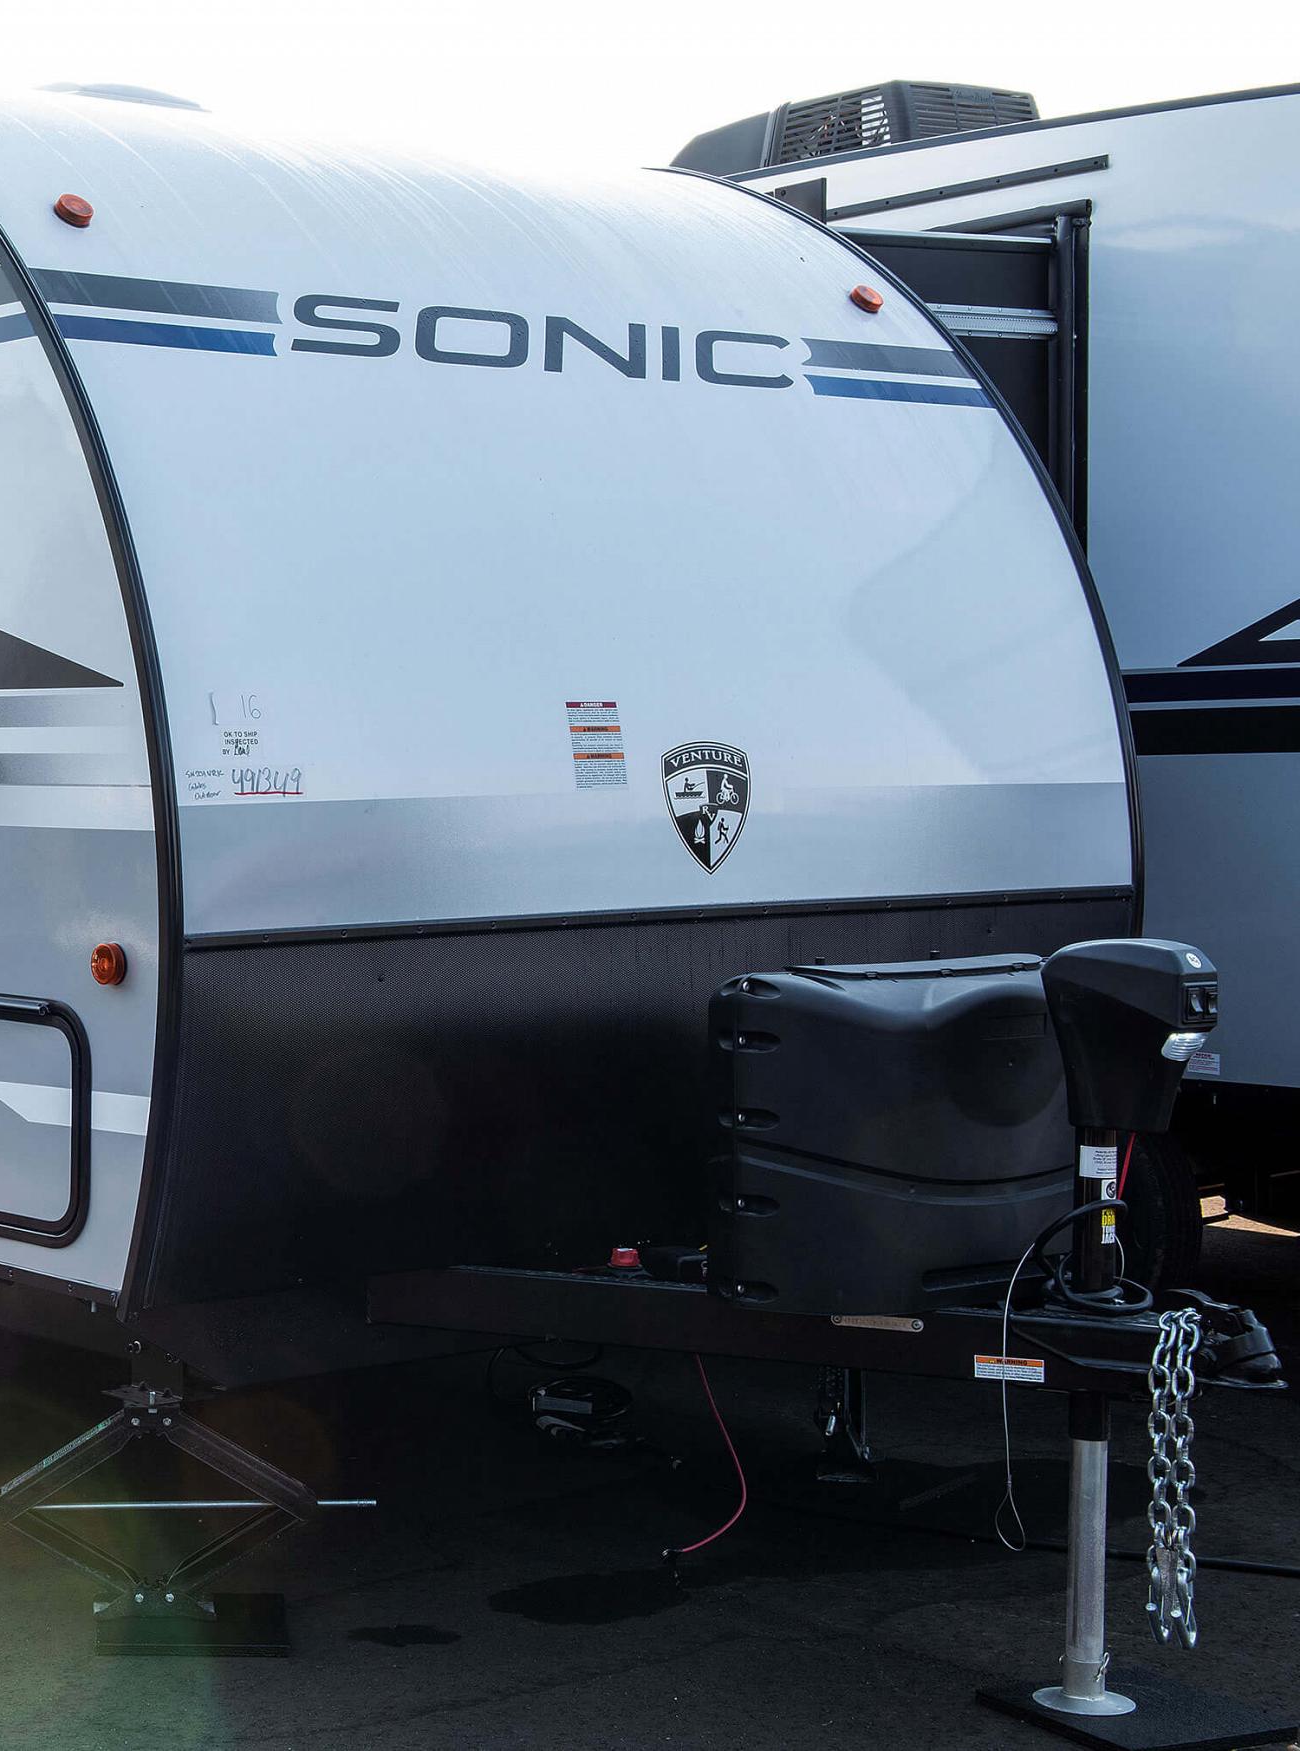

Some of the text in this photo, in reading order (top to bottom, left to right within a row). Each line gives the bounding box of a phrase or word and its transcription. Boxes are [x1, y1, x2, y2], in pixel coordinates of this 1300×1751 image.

[290, 293, 794, 389] SONIC
[670, 750, 743, 768] VENTURE
[702, 805, 715, 821] RV
